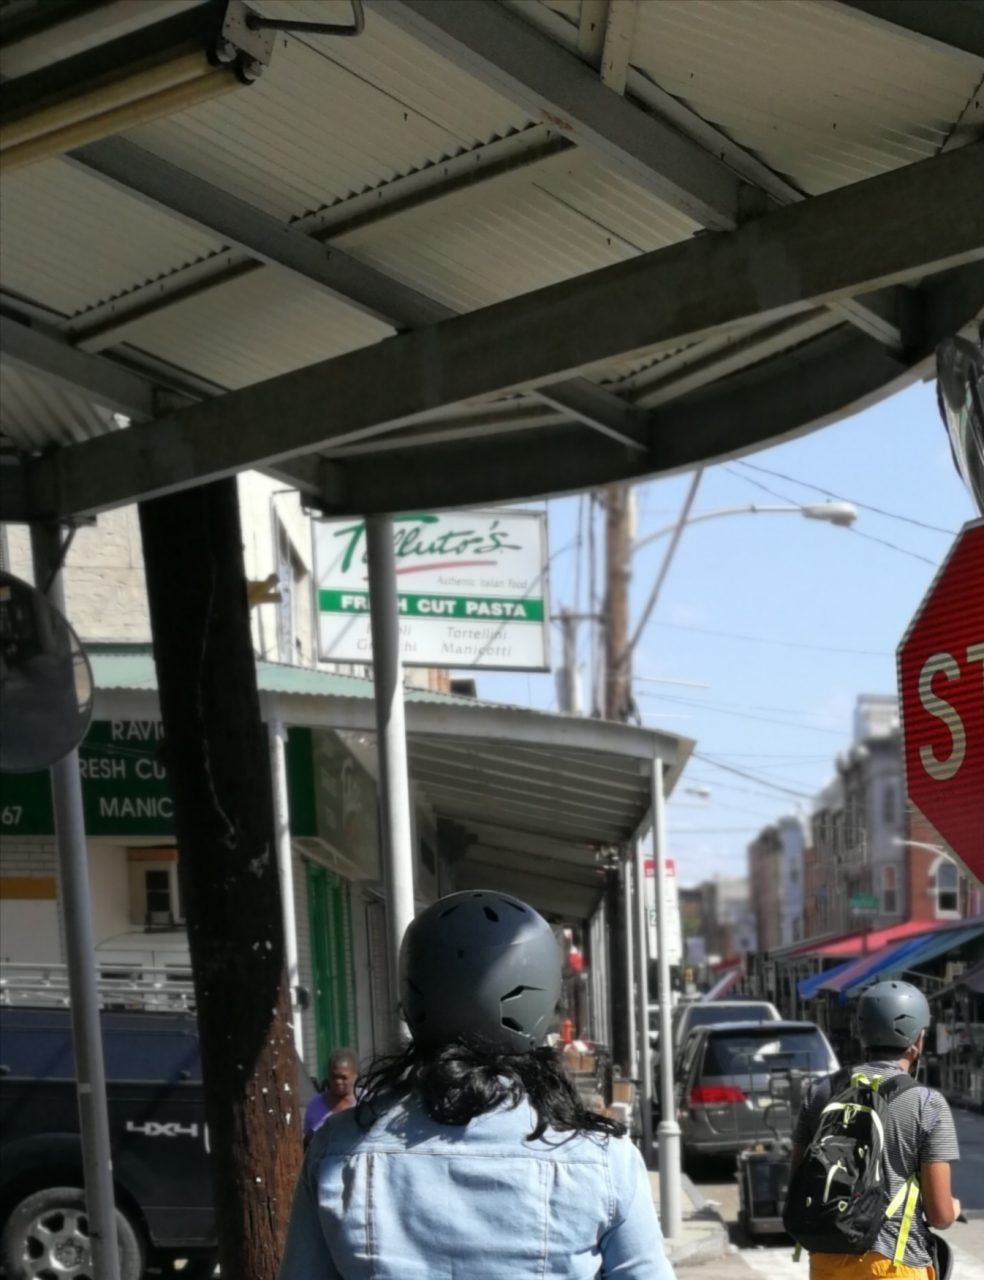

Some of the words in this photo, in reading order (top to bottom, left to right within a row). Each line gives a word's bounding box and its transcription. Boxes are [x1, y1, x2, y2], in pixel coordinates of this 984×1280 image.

[333, 514, 522, 573] Tlluto's
[341, 594, 407, 612] FRH
[417, 599, 456, 613] CUT
[466, 602, 526, 617] PASTA
[100, 797, 174, 818] MANIC
